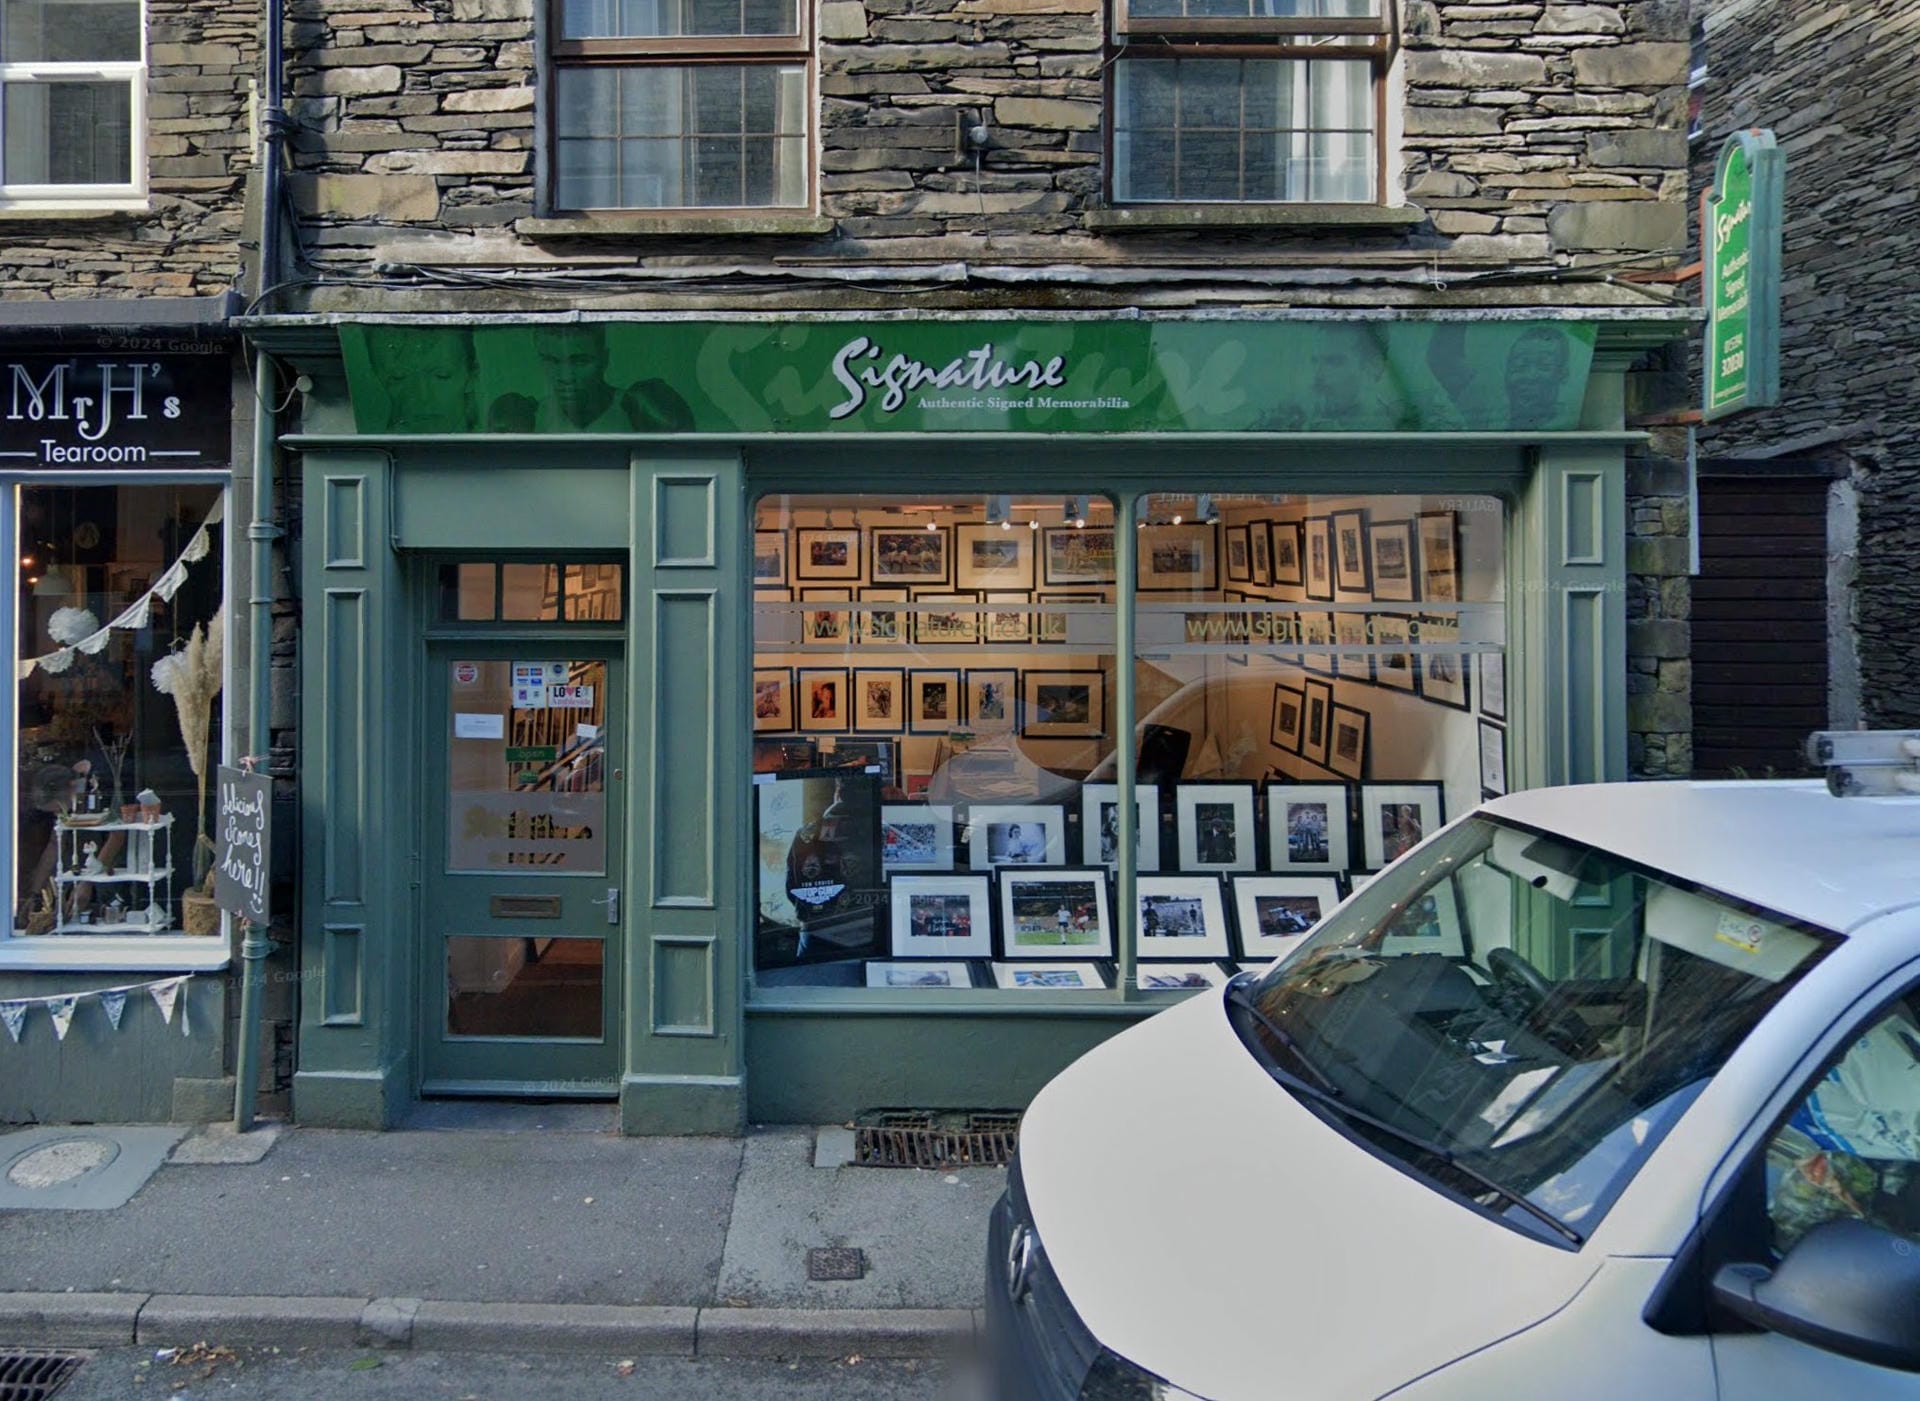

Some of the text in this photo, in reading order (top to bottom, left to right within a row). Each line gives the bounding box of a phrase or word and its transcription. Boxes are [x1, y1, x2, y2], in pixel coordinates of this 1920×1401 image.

[830, 336, 1066, 419] Signature
[917, 397, 1130, 412] Authentic Signed Memorabilia
[40, 439, 146, 462] Tearoom
